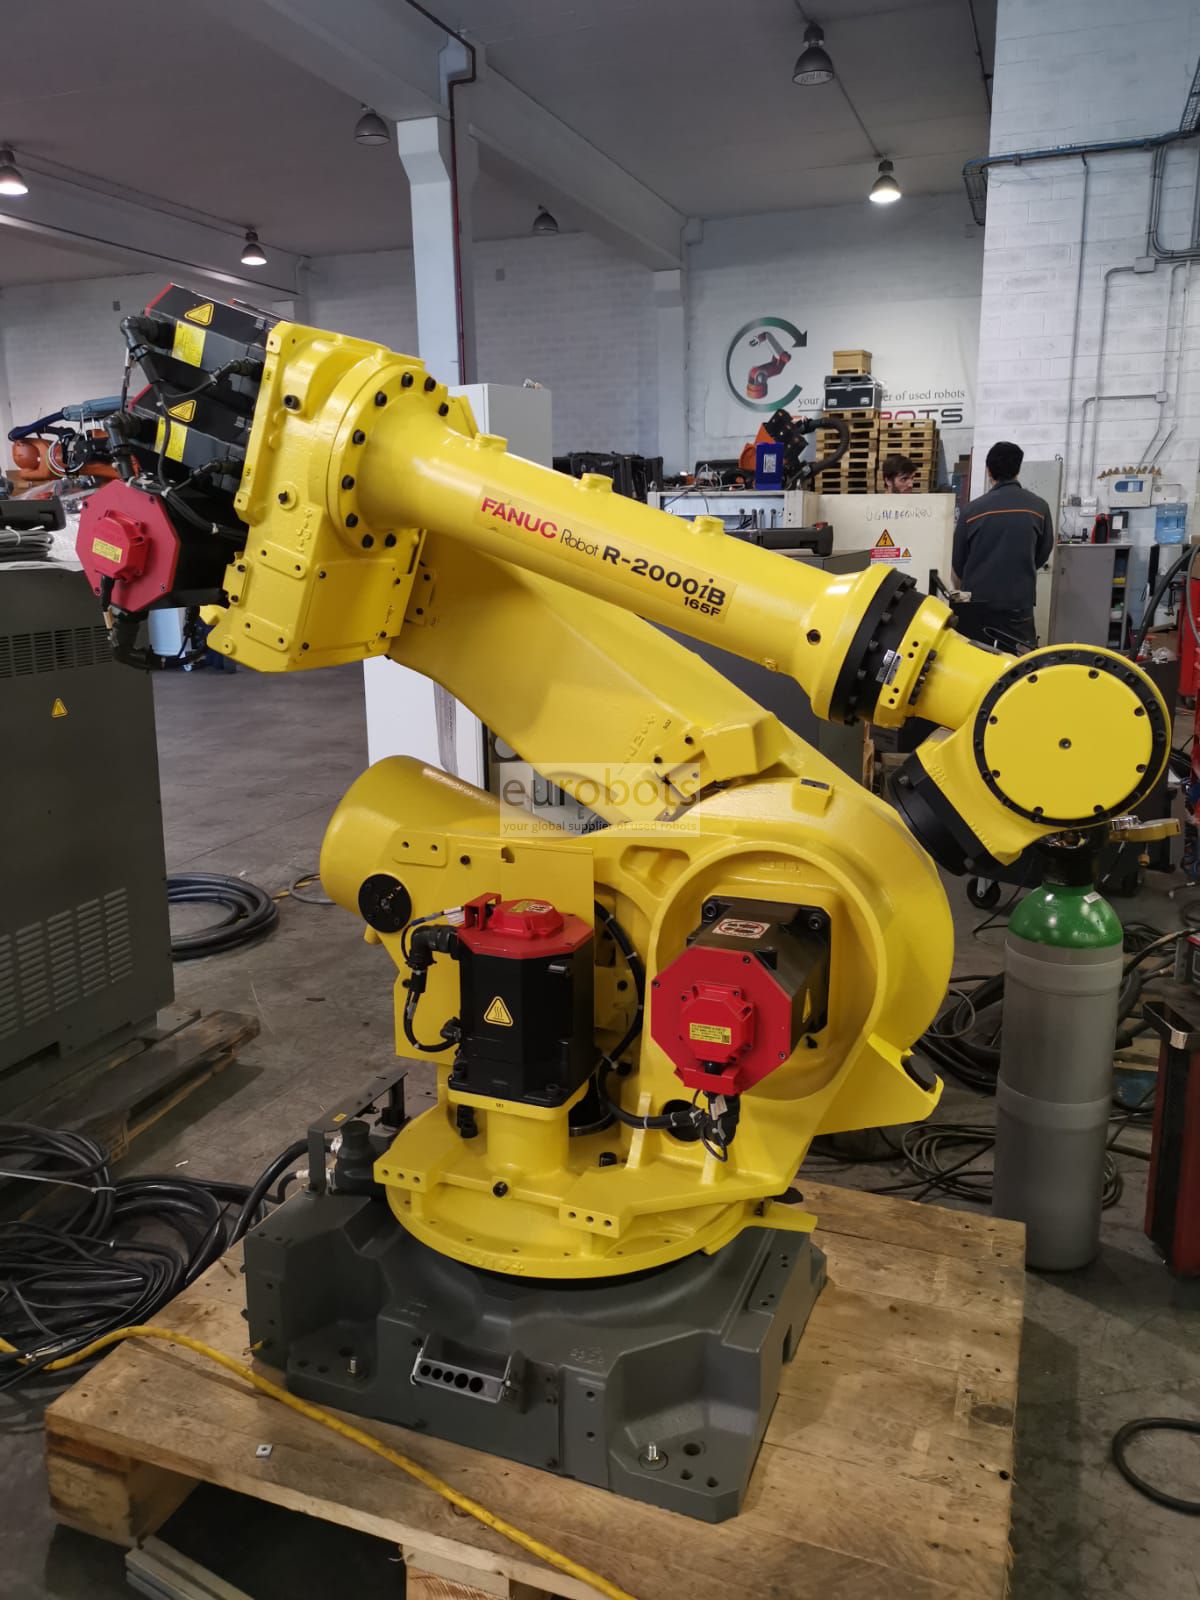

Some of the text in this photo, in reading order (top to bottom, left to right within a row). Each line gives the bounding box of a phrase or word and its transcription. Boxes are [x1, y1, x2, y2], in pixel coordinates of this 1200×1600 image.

[798, 397, 819, 408] your
[895, 390, 905, 401] of
[909, 389, 931, 400] used
[934, 389, 965, 400] robots
[481, 497, 726, 607] FANUC Robot R-2000iB
[683, 596, 721, 617] 165F
